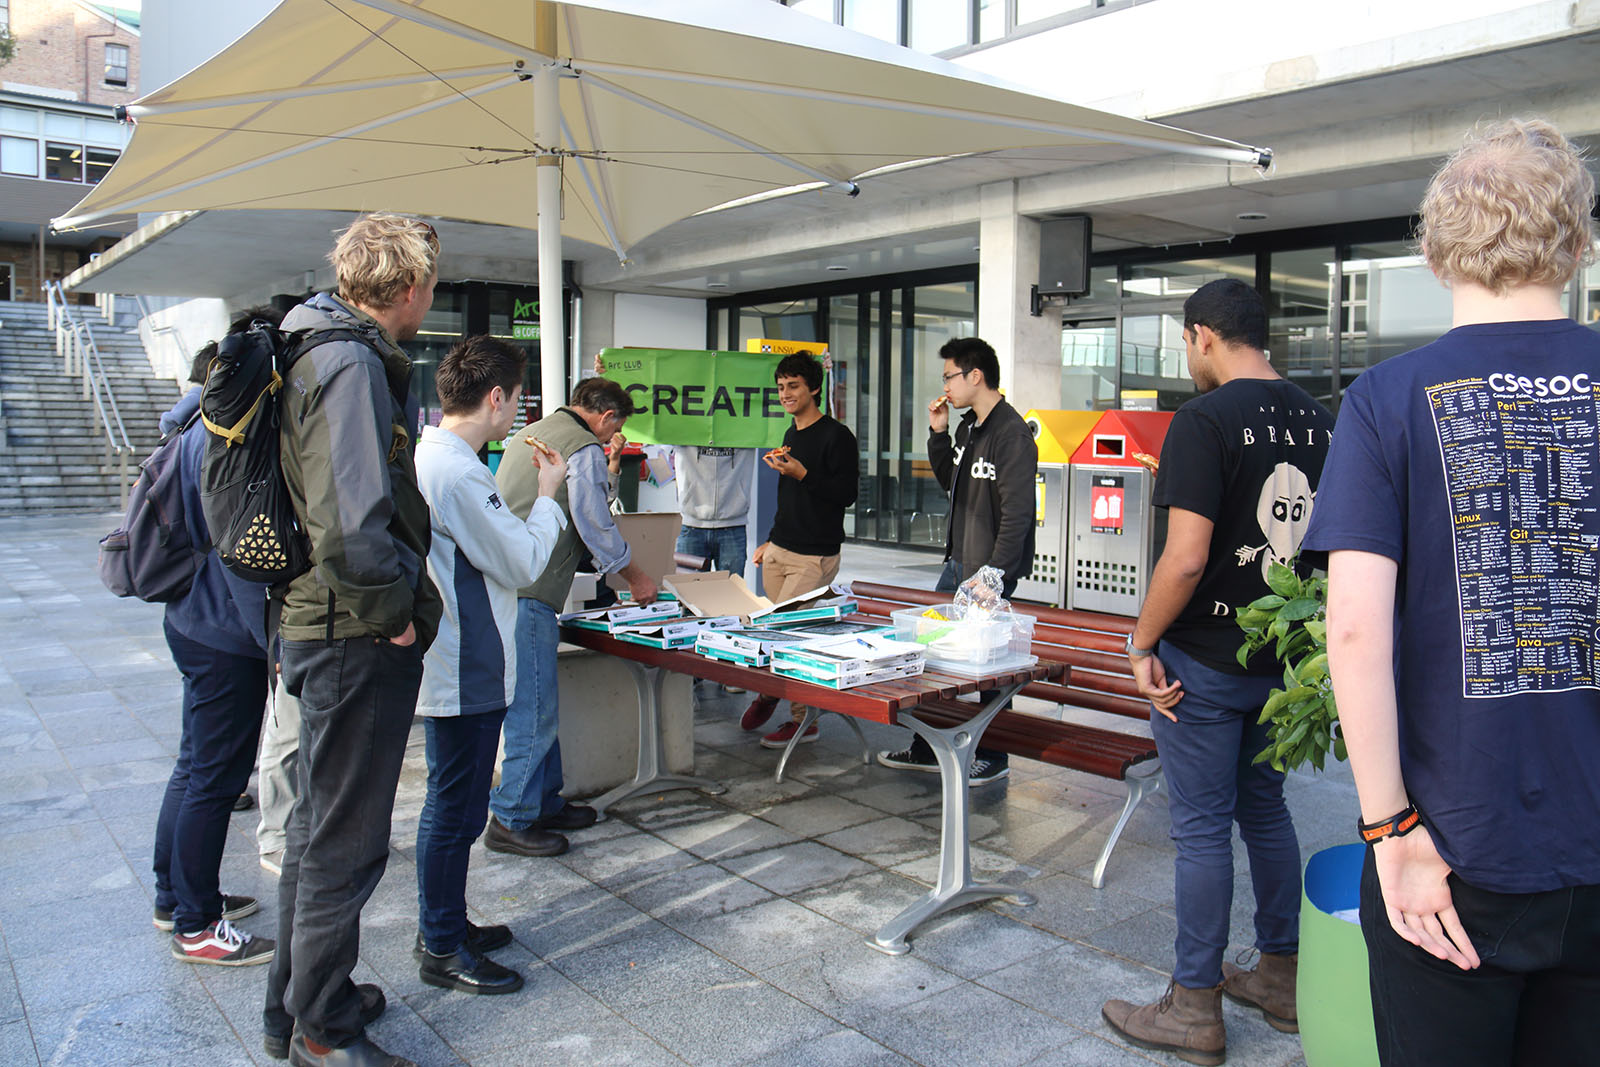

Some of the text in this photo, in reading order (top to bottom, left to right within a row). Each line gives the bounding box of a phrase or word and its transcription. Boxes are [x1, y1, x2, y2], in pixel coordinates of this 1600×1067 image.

[624, 360, 642, 369] CLUB
[626, 383, 785, 418] CREATE
[1497, 401, 1517, 411] Perl
[1454, 514, 1481, 524] Linux
[1510, 529, 1529, 540] Git
[1516, 637, 1542, 647] Java
